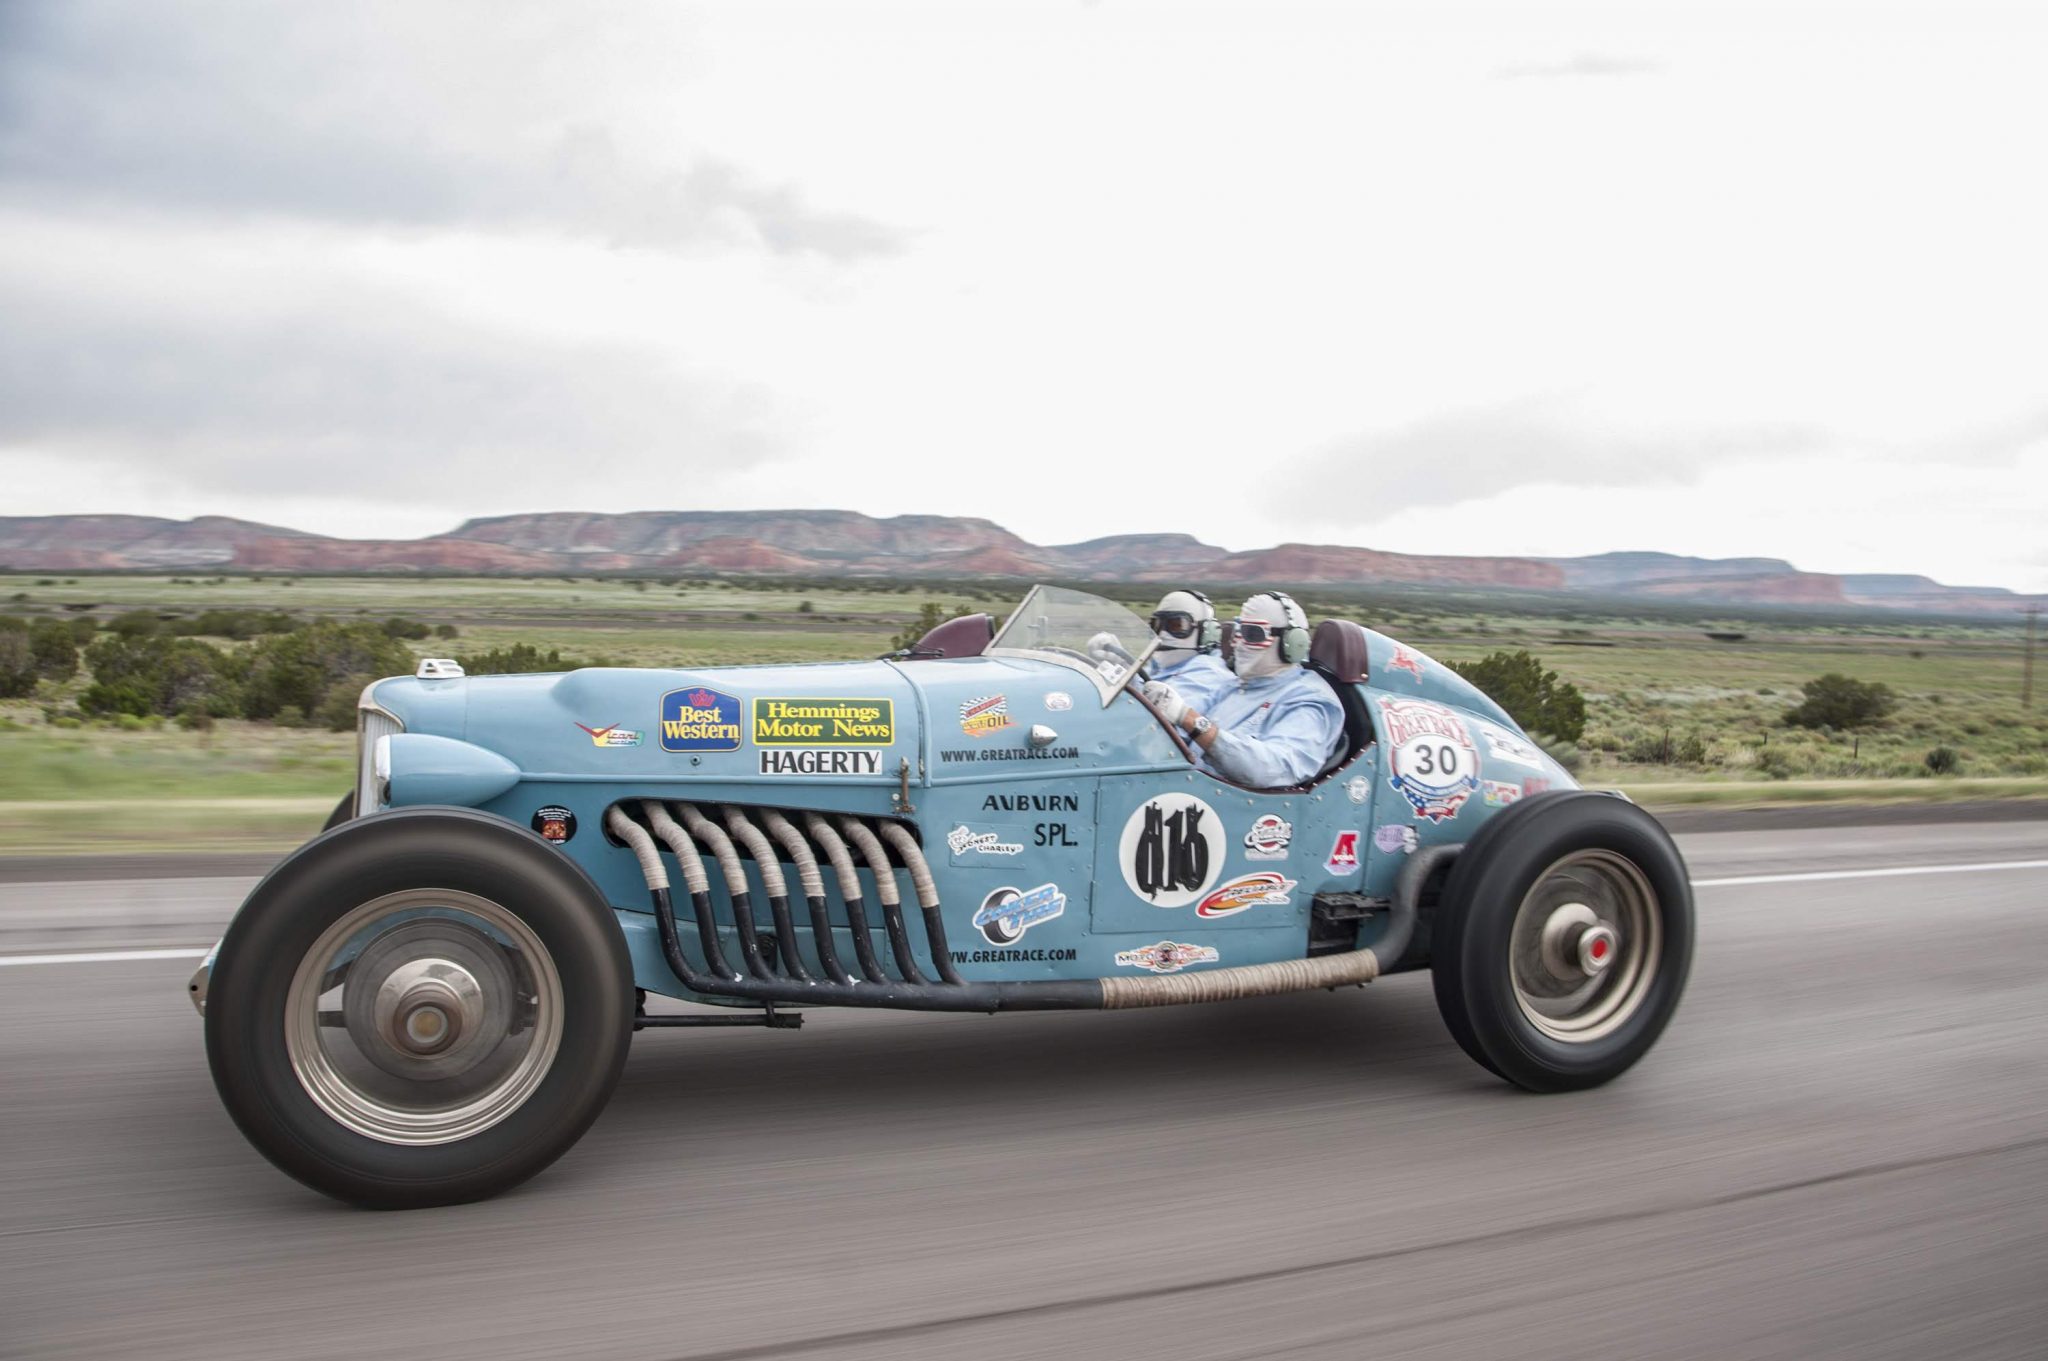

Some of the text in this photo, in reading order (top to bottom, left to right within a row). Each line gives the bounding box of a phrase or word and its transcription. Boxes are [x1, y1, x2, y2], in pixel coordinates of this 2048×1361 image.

[680, 706, 722, 723] Best
[767, 702, 880, 722] Hemmings
[663, 720, 740, 739] Western
[757, 719, 890, 737] Motor News
[987, 715, 1009, 728] OIL
[761, 750, 880, 774] HAGERTY
[940, 747, 1079, 762] WWW.GREATRACE.COM
[1415, 744, 1457, 776] 30
[982, 795, 1079, 811] AUBURN
[1034, 823, 1078, 847] SPL.
